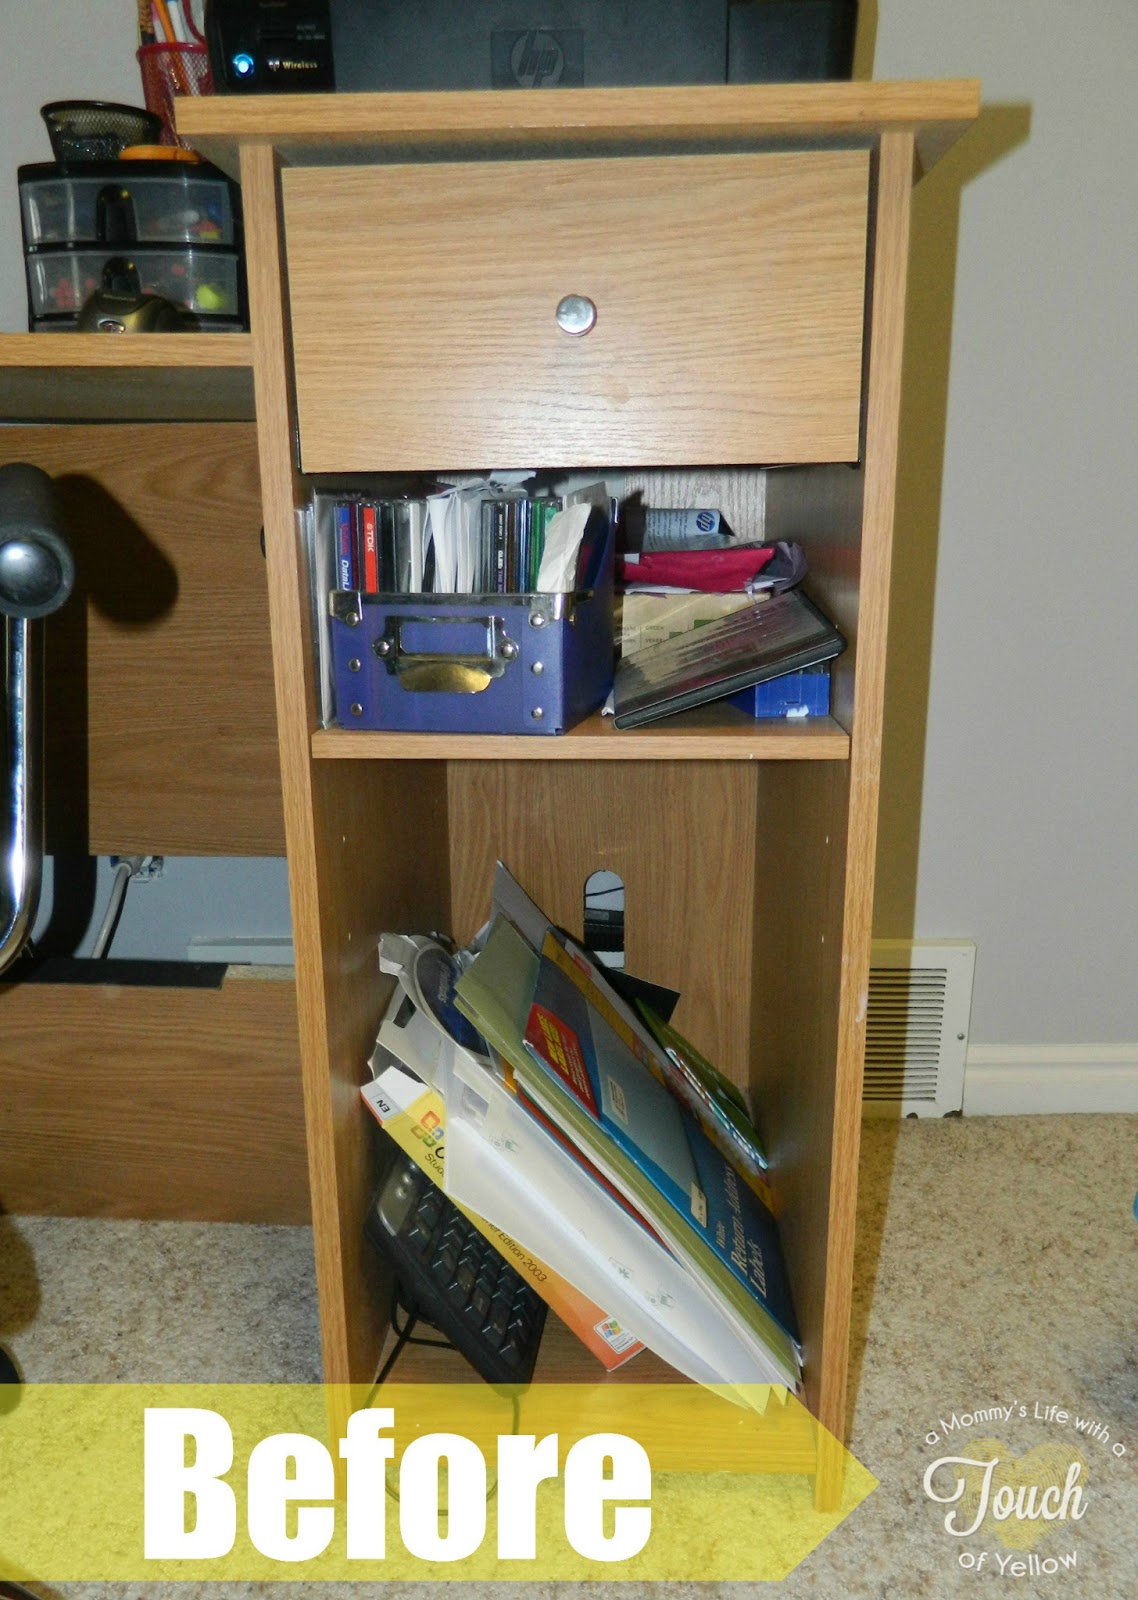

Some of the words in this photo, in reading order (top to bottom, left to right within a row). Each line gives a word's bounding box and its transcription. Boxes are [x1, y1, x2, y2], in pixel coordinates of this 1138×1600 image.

[282, 60, 318, 69] Wireless
[367, 529, 375, 552] TDK
[376, 1099, 391, 1113] EN
[498, 1232, 526, 1260] Edition
[522, 1258, 548, 1282] 2003
[730, 1215, 748, 1277] Return
[746, 1238, 767, 1299] Labels
